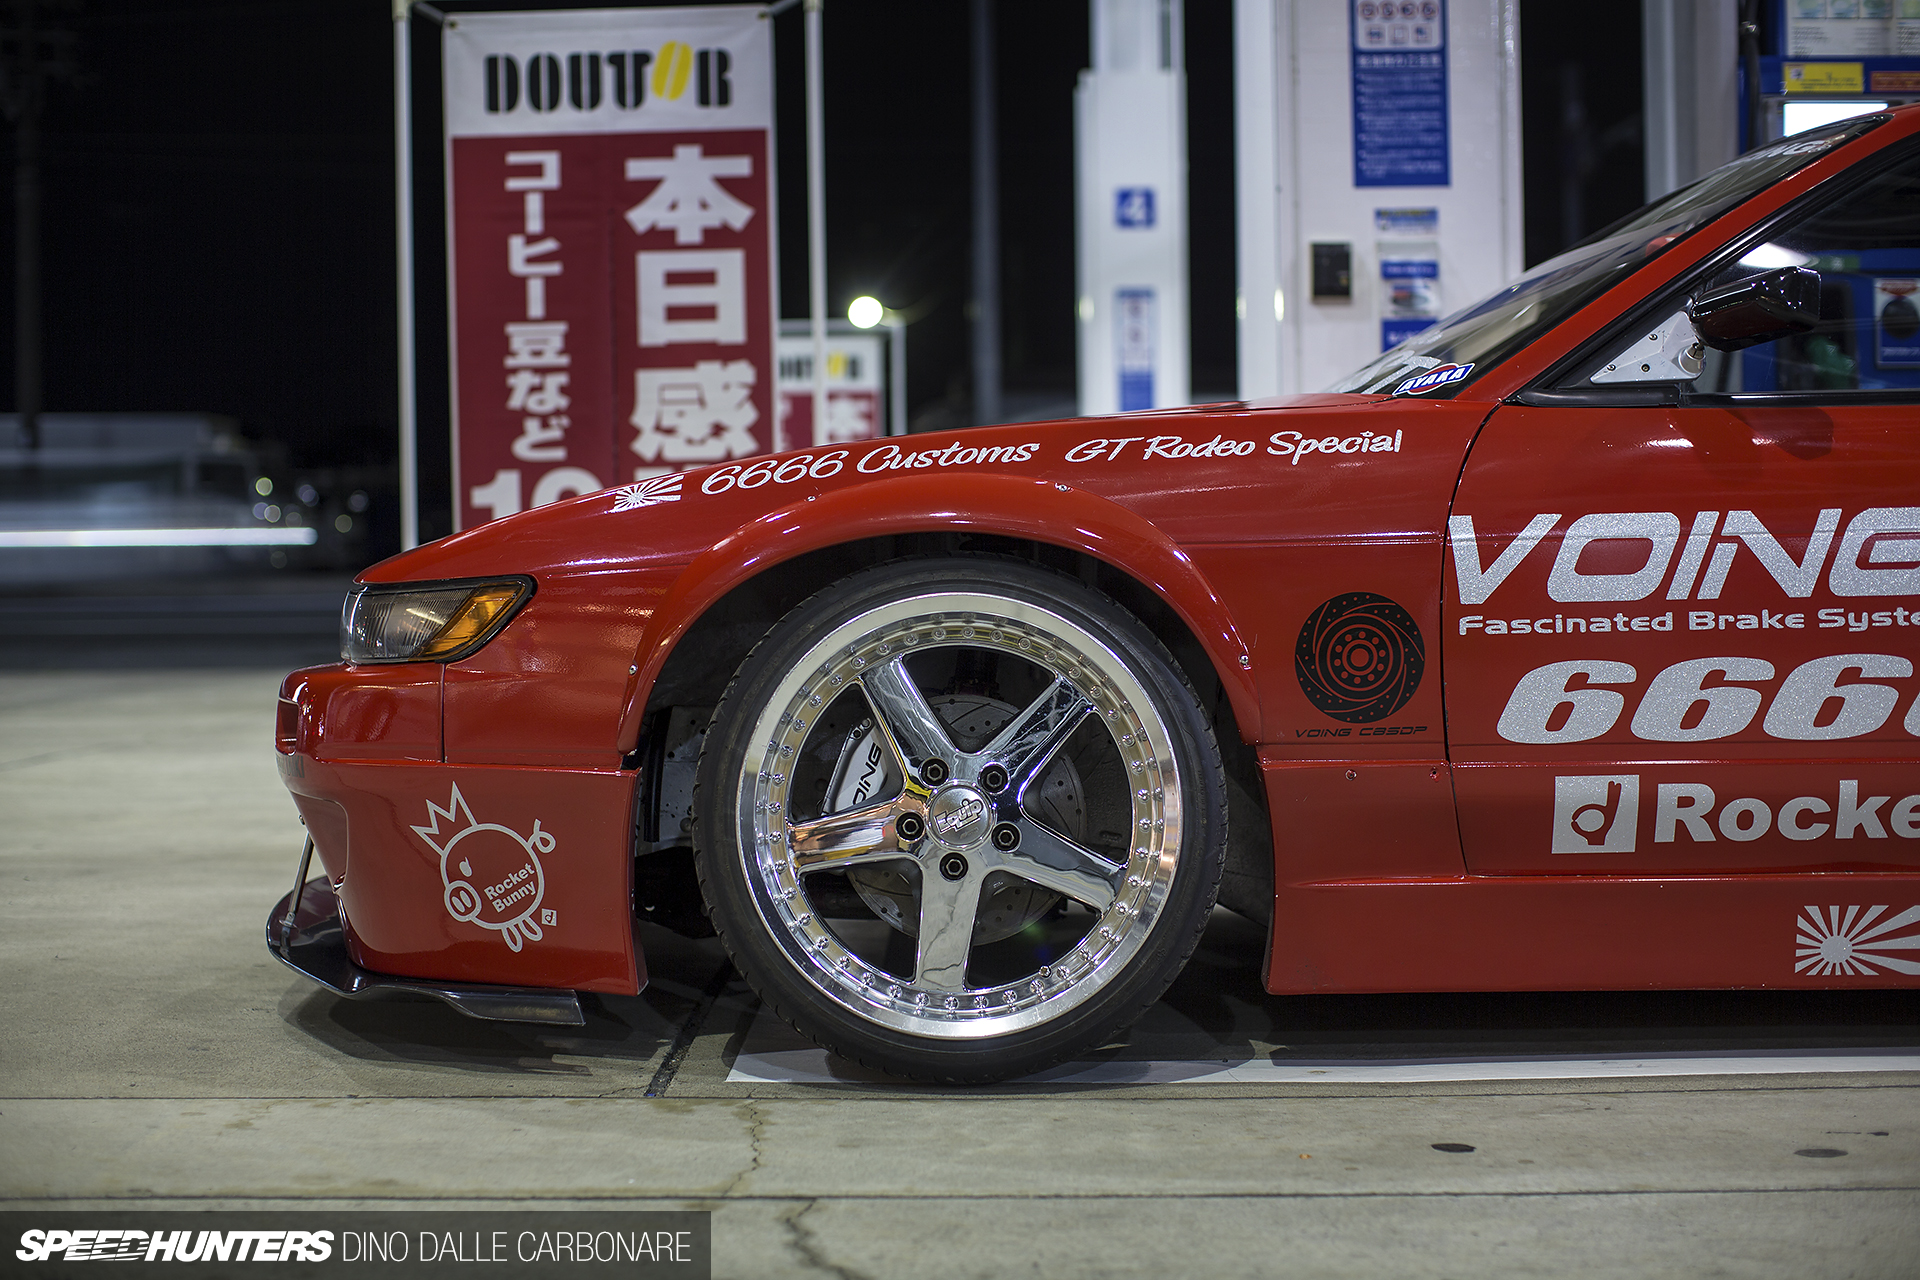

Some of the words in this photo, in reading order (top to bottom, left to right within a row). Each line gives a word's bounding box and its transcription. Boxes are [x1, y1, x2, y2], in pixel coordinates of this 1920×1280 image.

[483, 41, 733, 114] DOUTOR
[505, 150, 571, 462] コーヒー豆など
[625, 144, 760, 481] 本日感
[1398, 366, 1467, 393] AYAKA
[701, 450, 849, 495] 6666
[856, 441, 1041, 474] Customs
[1064, 437, 1144, 463] GT
[1143, 434, 1256, 461] Rodeo
[1266, 429, 1403, 466] Special
[1459, 611, 1674, 636] Fascinated
[1688, 609, 1805, 631] Brake
[1496, 653, 1920, 745] 666
[1295, 728, 1353, 738] VOING
[852, 741, 883, 806] OING
[483, 862, 536, 901] Rocket
[491, 880, 537, 914] Bunny
